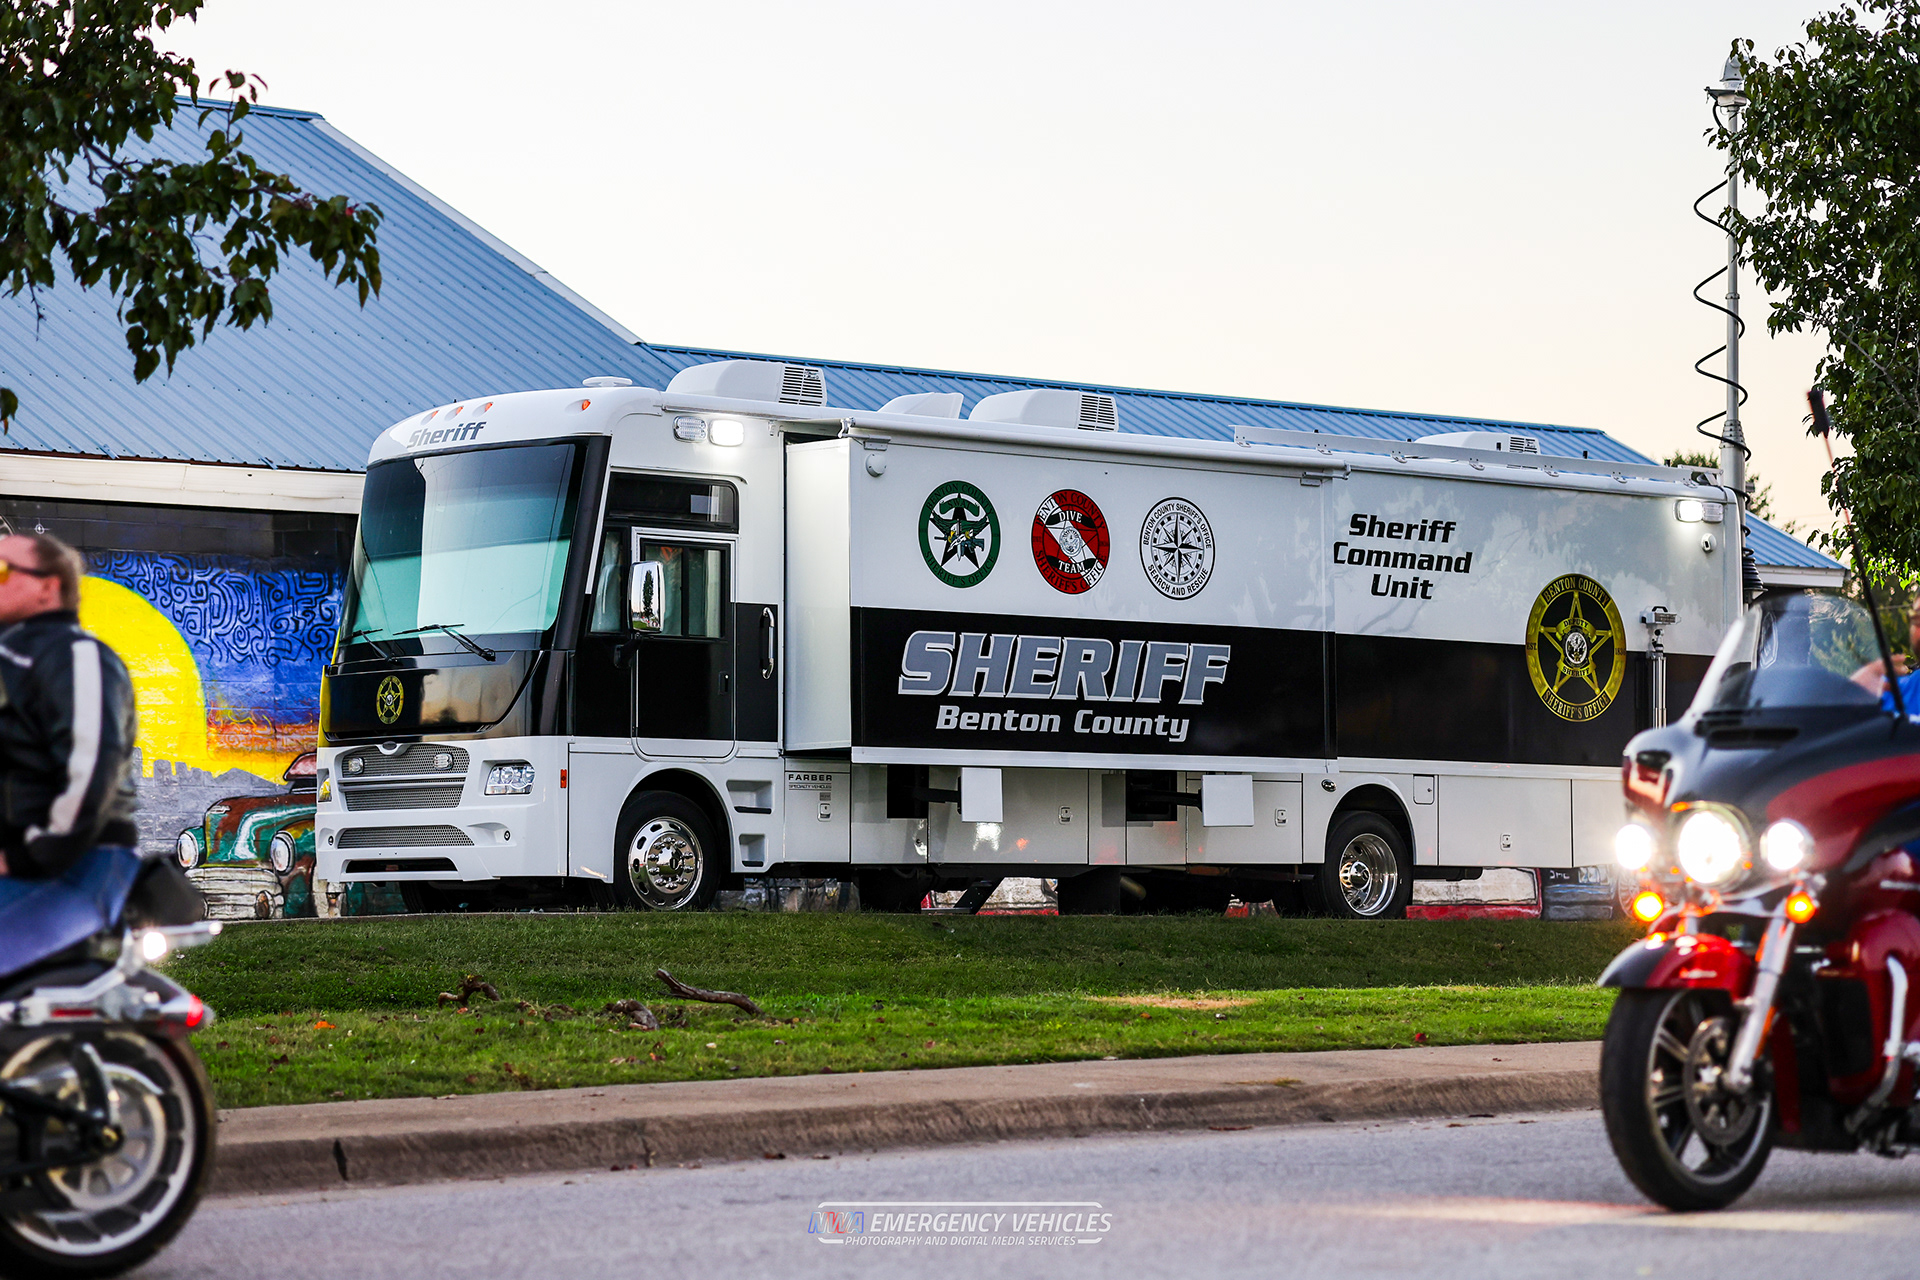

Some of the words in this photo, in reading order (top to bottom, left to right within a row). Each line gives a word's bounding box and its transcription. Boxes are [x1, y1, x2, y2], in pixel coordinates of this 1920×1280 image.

[407, 421, 487, 448] Sheriff
[925, 483, 959, 512] BENTON
[961, 484, 995, 515] COUNTY
[948, 499, 971, 508] SWAT
[1035, 492, 1067, 527] BENTON
[1071, 492, 1105, 529] COUNTY
[1058, 511, 1082, 522] DIVE
[1143, 516, 1156, 545] BENTON
[1154, 503, 1175, 519] COUNTY
[1175, 503, 1202, 524] SHERIFF'S
[1200, 523, 1212, 549] OFFICE
[1349, 513, 1456, 543] Sheriff
[925, 551, 966, 585] SHERIFF'S
[968, 556, 996, 584] OFFICE
[1058, 560, 1085, 573] TEAM
[1080, 554, 1106, 590] OFFICE
[1333, 541, 1473, 573] Command
[1147, 564, 1171, 592] SEARCH
[1171, 586, 1185, 595] AND
[1187, 568, 1208, 593] RESCUE
[1371, 573, 1433, 600] Unit
[1543, 577, 1576, 603] BENTON
[1578, 577, 1610, 606] COUNTY
[1564, 617, 1589, 628] DEPUTY
[898, 630, 1231, 705] SHERIFF
[1562, 666, 1590, 676] SHERIFF
[1543, 690, 1583, 719] SHERIFF'S
[1584, 693, 1611, 719] OFFICE
[936, 705, 1061, 732] Benton
[1074, 710, 1189, 742] County
